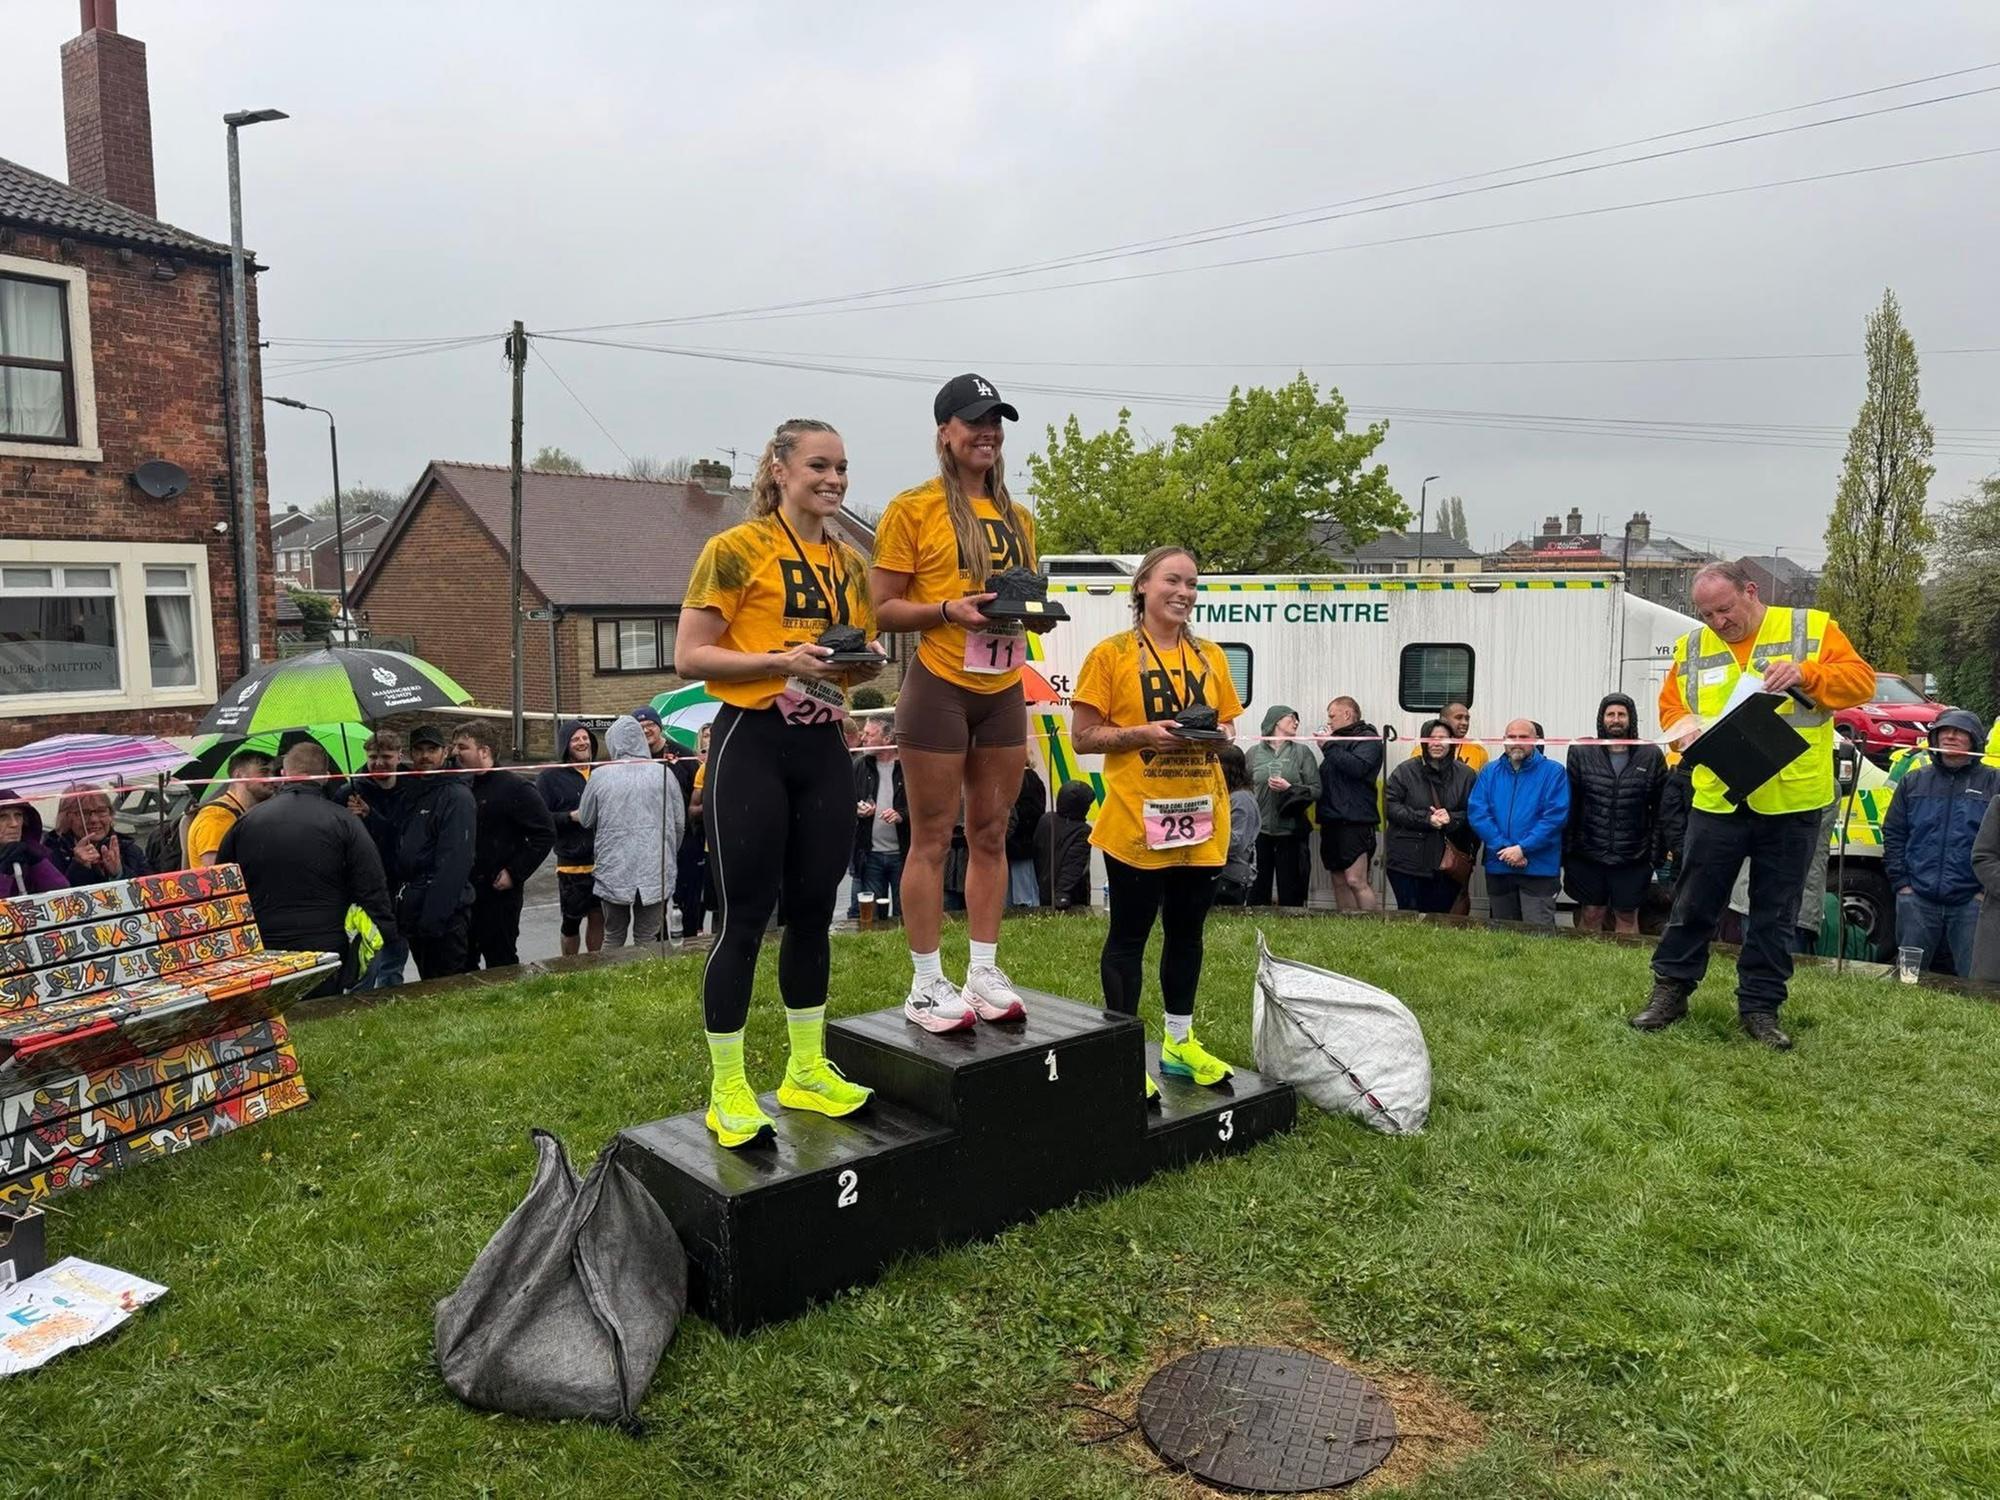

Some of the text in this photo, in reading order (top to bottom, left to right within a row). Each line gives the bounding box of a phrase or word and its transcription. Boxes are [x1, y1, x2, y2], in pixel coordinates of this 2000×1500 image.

[972, 379, 993, 396] LA
[1193, 603, 1389, 622] TMENT CENTRE
[986, 639, 1014, 667] 11
[0, 664, 35, 674] LDER
[50, 661, 103, 672] MUTTON
[1050, 675, 1070, 692] St
[1161, 815, 1196, 841] 28
[1044, 1049, 1059, 1082] 1
[1218, 1110, 1234, 1141] 3
[838, 1169, 858, 1208] 2
